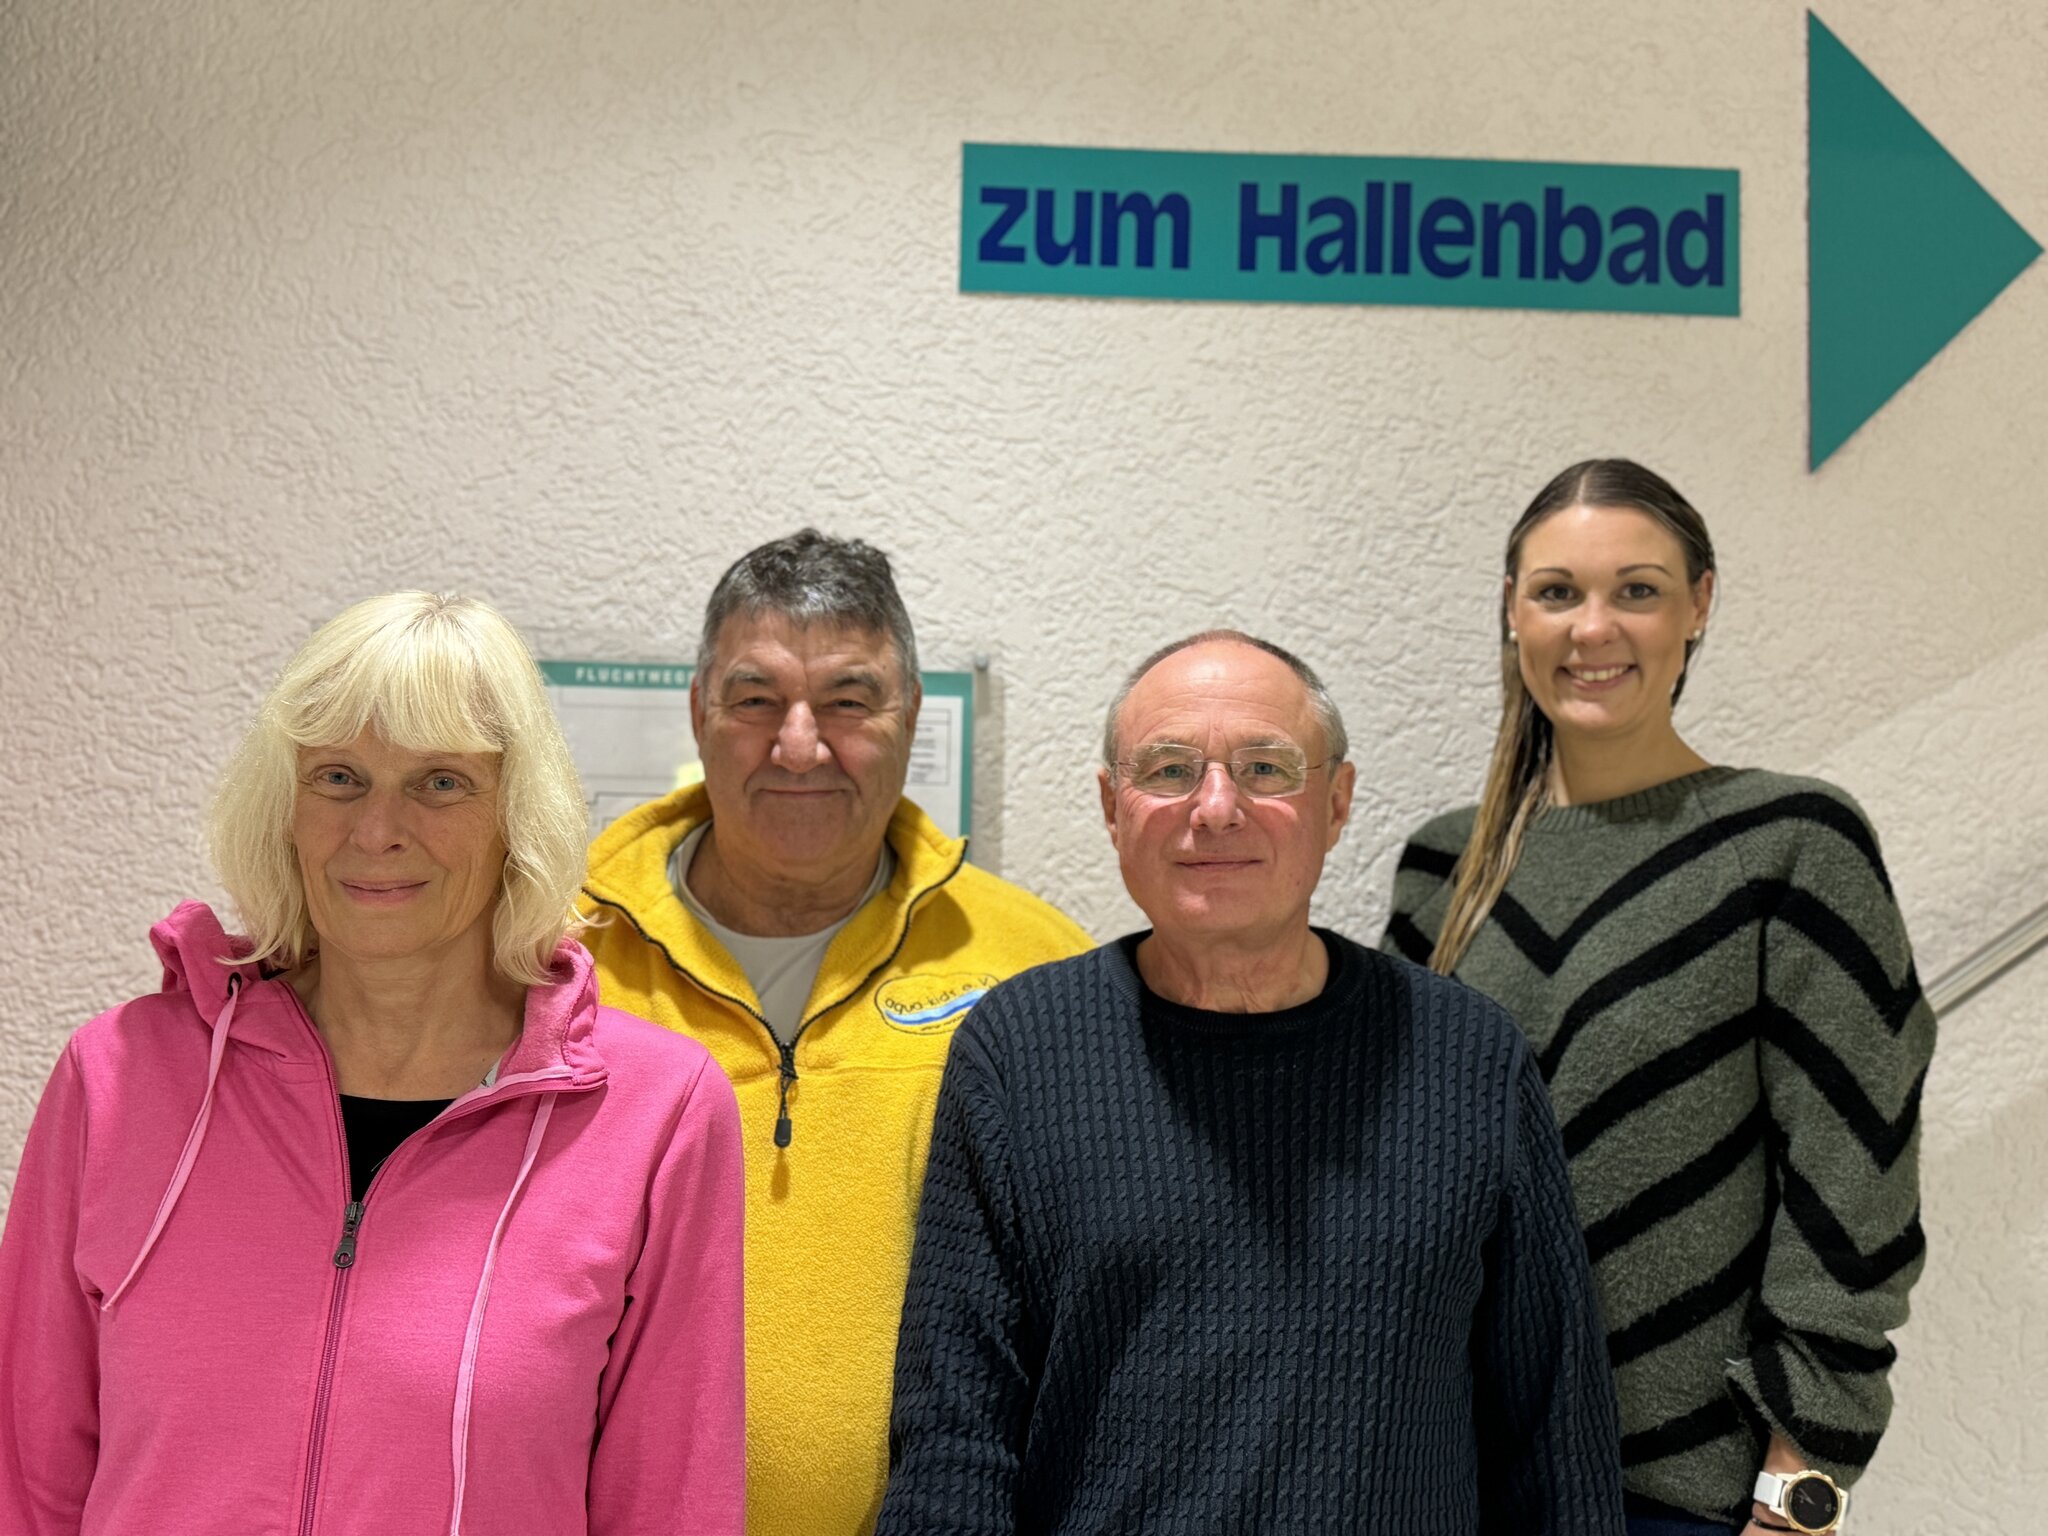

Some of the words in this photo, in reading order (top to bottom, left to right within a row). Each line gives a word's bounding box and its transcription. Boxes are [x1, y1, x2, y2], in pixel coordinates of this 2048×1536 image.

[979, 186, 1191, 270] zum
[1238, 181, 1726, 288] Hallenbad
[885, 997, 923, 1015] aqua
